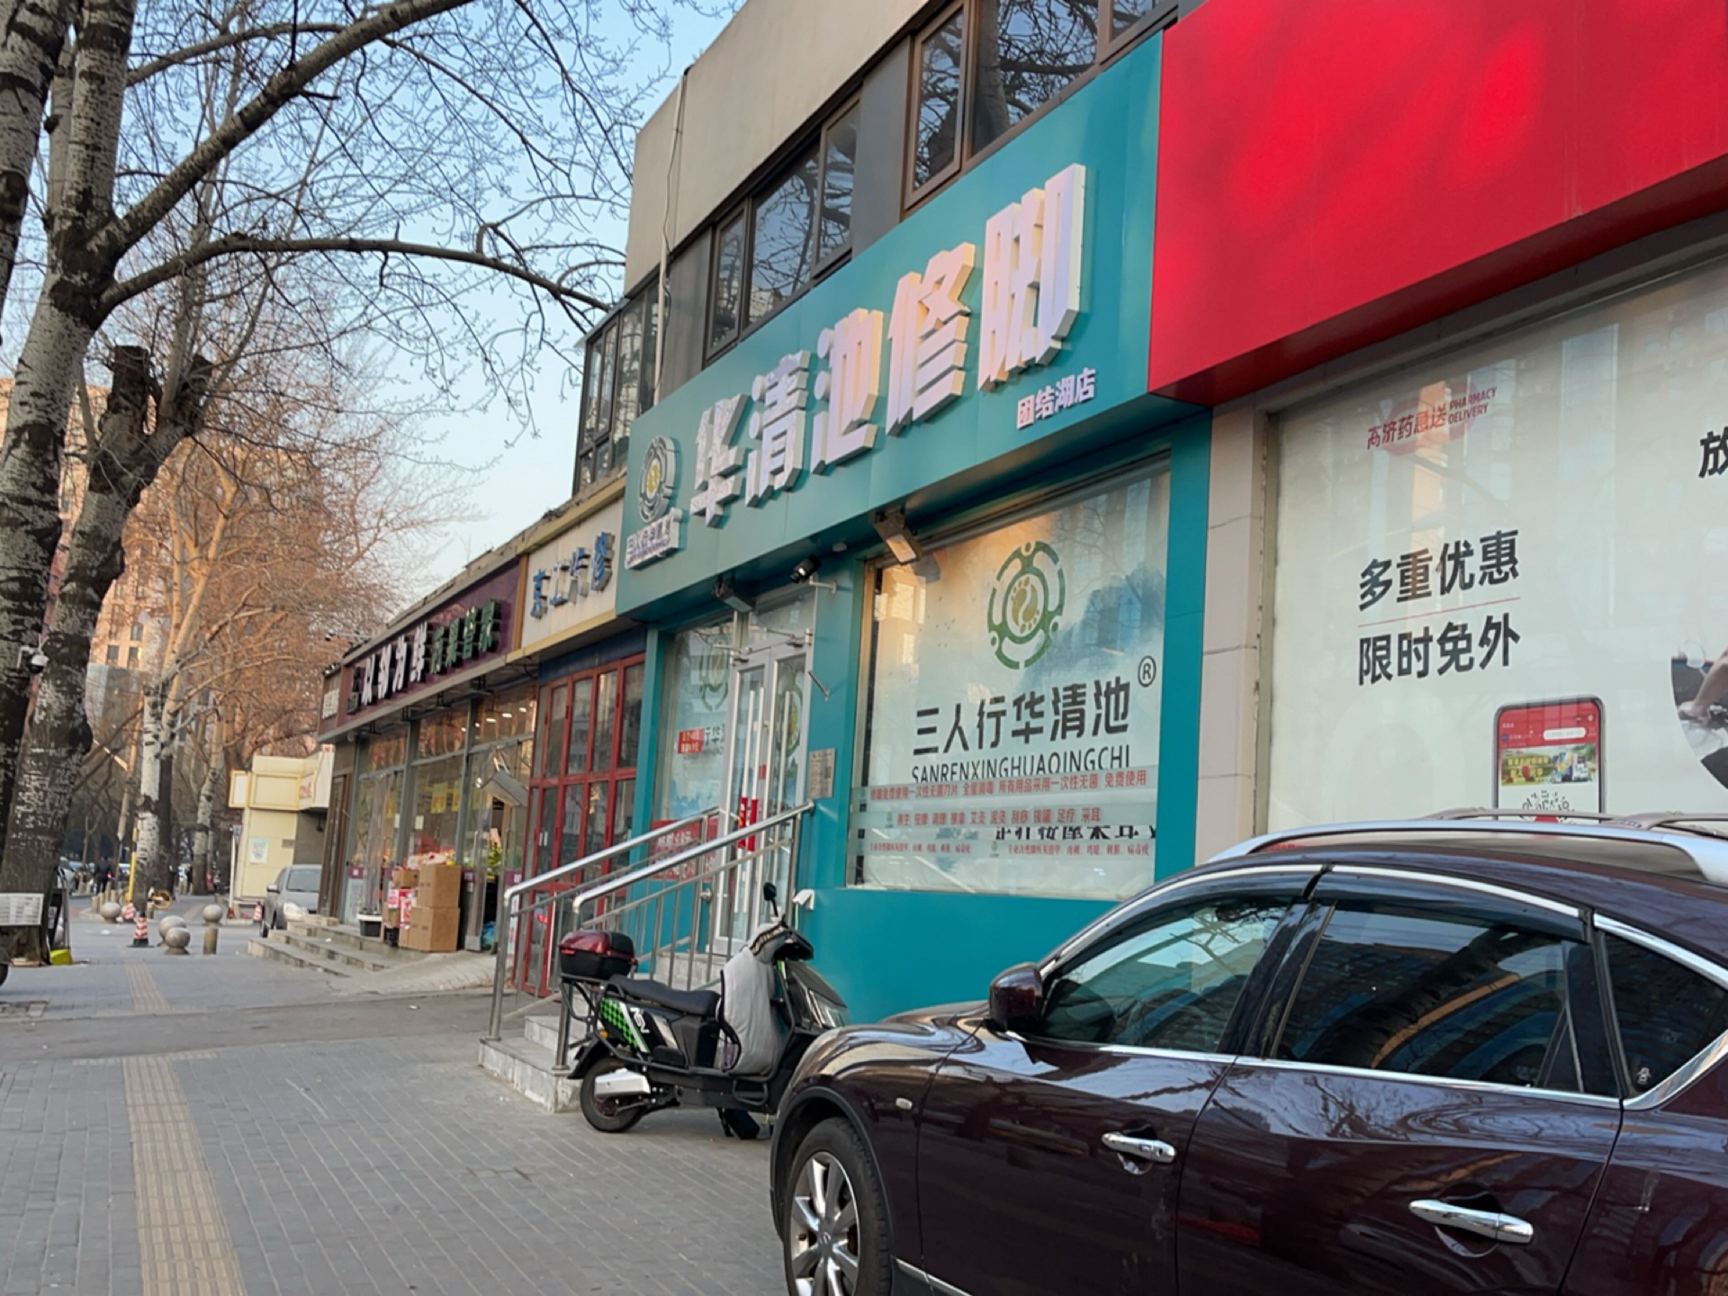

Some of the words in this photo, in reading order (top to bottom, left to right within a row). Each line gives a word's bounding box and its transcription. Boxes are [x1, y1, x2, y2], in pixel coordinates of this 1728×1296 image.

[690, 163, 1086, 528] 华清池修脚
[1016, 367, 1096, 429] 团结湖店
[1367, 405, 1447, 450] 高济药急送
[1448, 403, 1489, 425] DELIVERY
[1449, 387, 1497, 410] PHARMACY
[1359, 529, 1519, 612] 多重优惠
[1358, 612, 1520, 686] 限时免外
[912, 676, 1130, 756] 三人行华清池
